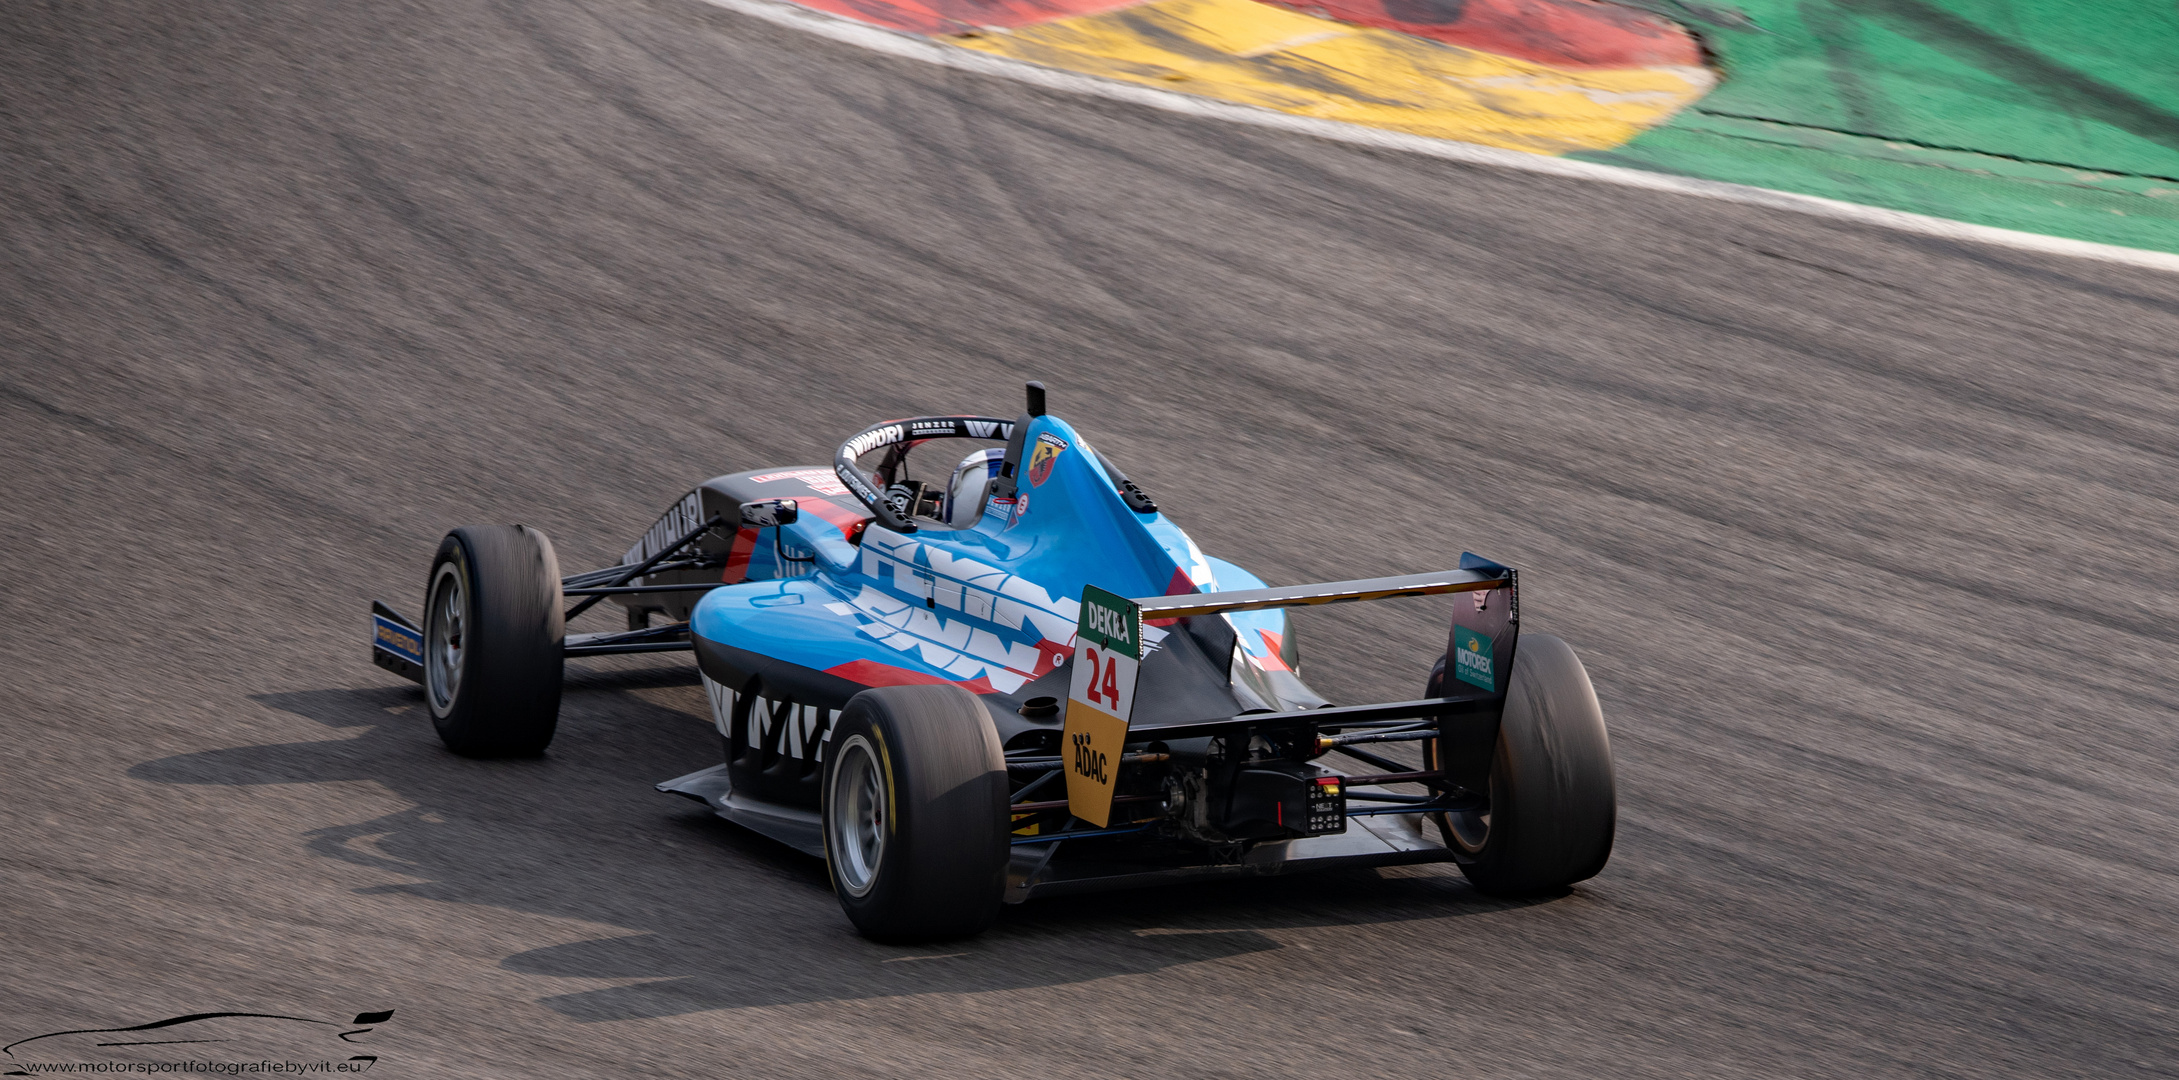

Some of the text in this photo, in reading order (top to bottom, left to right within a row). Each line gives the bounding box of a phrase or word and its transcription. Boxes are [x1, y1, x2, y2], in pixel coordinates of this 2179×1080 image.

[849, 424, 904, 456] WIHURI
[912, 421, 955, 430] JENZER
[1088, 601, 1130, 644] DEKRA
[1086, 647, 1119, 711] 24
[1457, 647, 1492, 674] MOTOREX
[1074, 742, 1108, 785] ADAC
